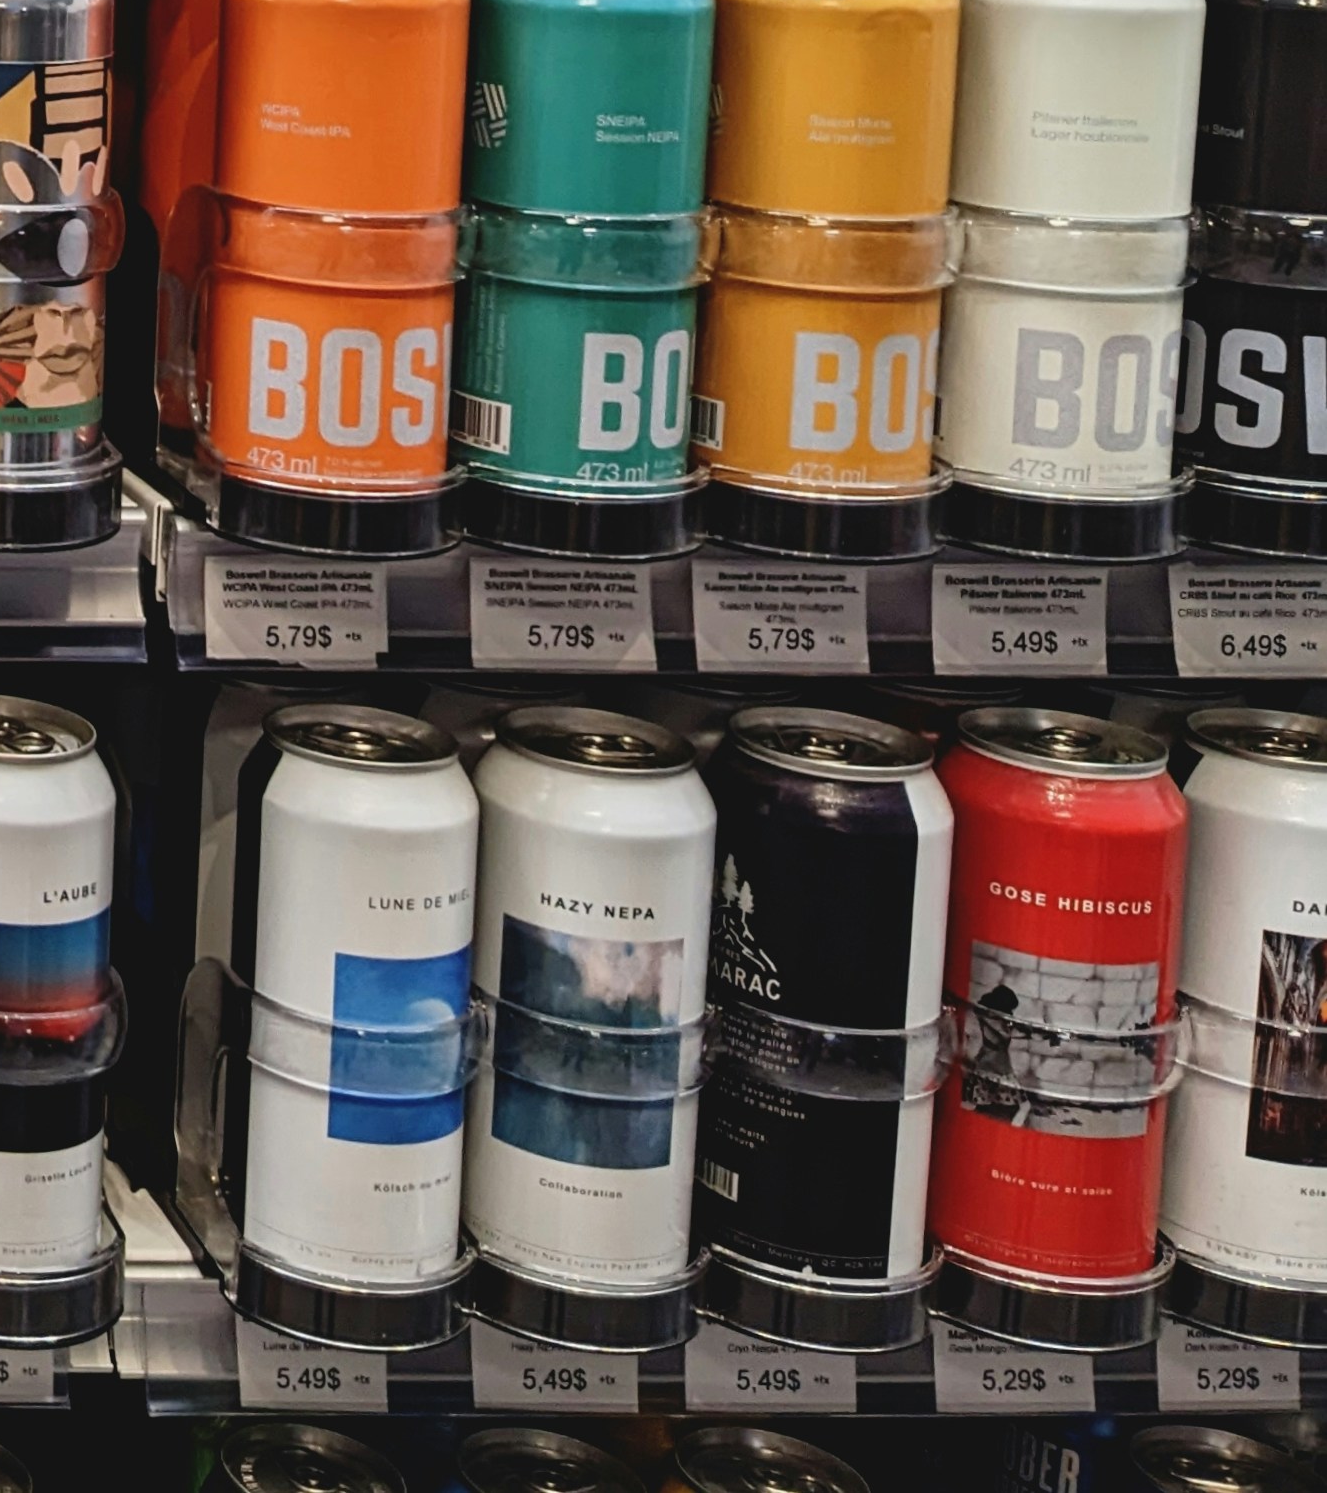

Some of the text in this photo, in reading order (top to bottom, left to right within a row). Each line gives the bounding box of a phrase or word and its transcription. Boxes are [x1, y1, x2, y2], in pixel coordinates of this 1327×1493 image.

[596, 115, 646, 127] SNEIPA
[647, 131, 680, 143] NEIPA
[248, 317, 451, 448] BOS
[247, 447, 285, 471] 473
[1009, 458, 1057, 481] 473
[266, 626, 332, 650] 5,79$
[749, 629, 815, 654] 5,79$
[1221, 635, 1287, 659] 6,49$
[43, 883, 98, 905] L'AUBE
[368, 895, 443, 912] LUNE DE
[988, 881, 1153, 915] GOSE HIBISCUS
[539, 892, 655, 921] HAZY NEPA
[539, 1177, 623, 1201] Collaboration
[276, 1367, 341, 1391] 5,49$
[522, 1368, 587, 1392] 5,49$
[1197, 1368, 1260, 1391] 5,29$
